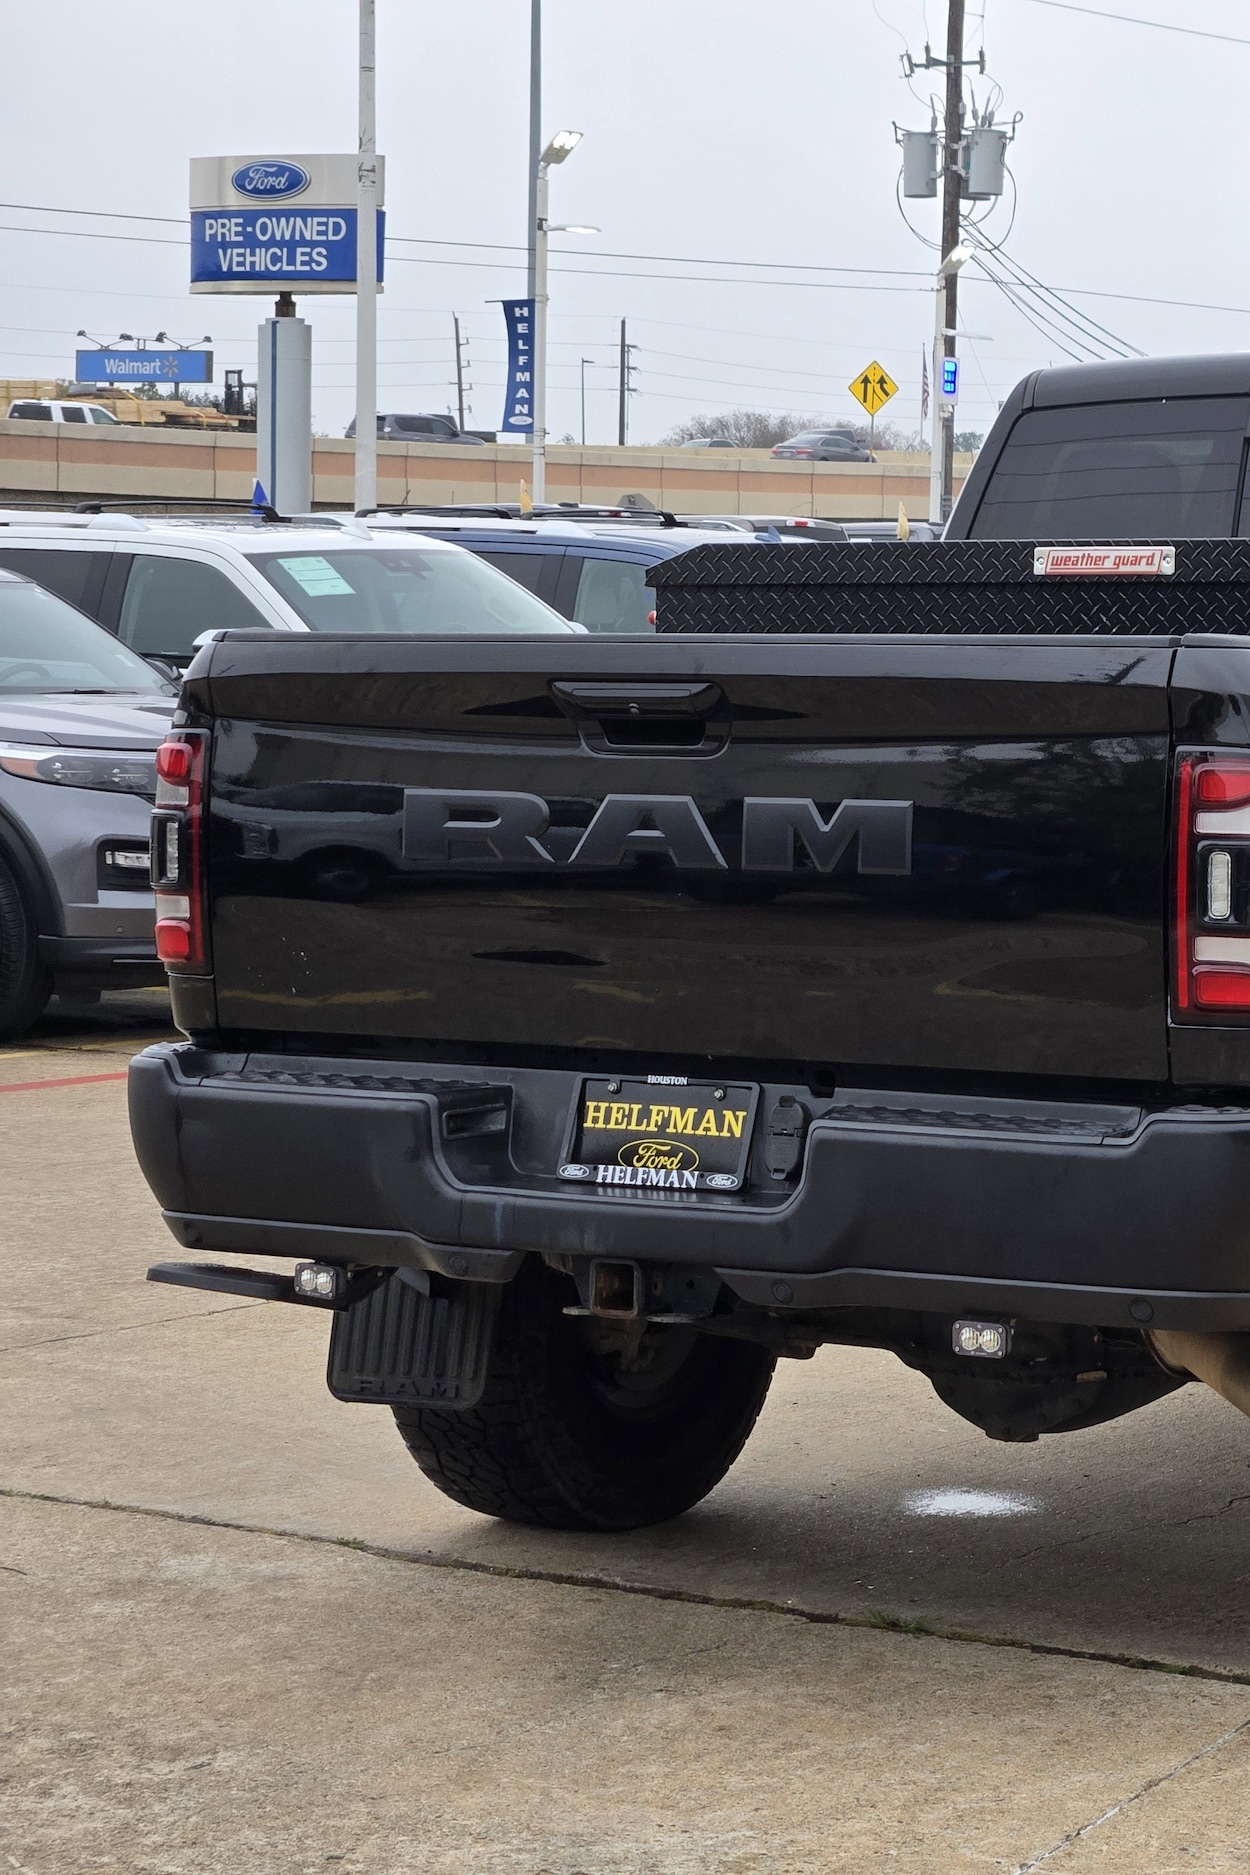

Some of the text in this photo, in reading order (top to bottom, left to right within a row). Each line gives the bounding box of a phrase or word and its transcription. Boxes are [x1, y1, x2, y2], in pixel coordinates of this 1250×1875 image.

[245, 166, 289, 190] Ford
[205, 217, 347, 242] PRE-OWNED
[218, 247, 328, 272] VEHICLES
[104, 358, 162, 375] Walmart
[514, 306, 531, 414] HELFMAN
[1050, 552, 1155, 570] weather guard
[402, 788, 914, 876] RAM
[647, 1075, 688, 1085] HOUSTON
[583, 1101, 748, 1138] HELFMAN
[632, 1143, 684, 1170] Ford
[595, 1165, 700, 1189] HELFMAN
